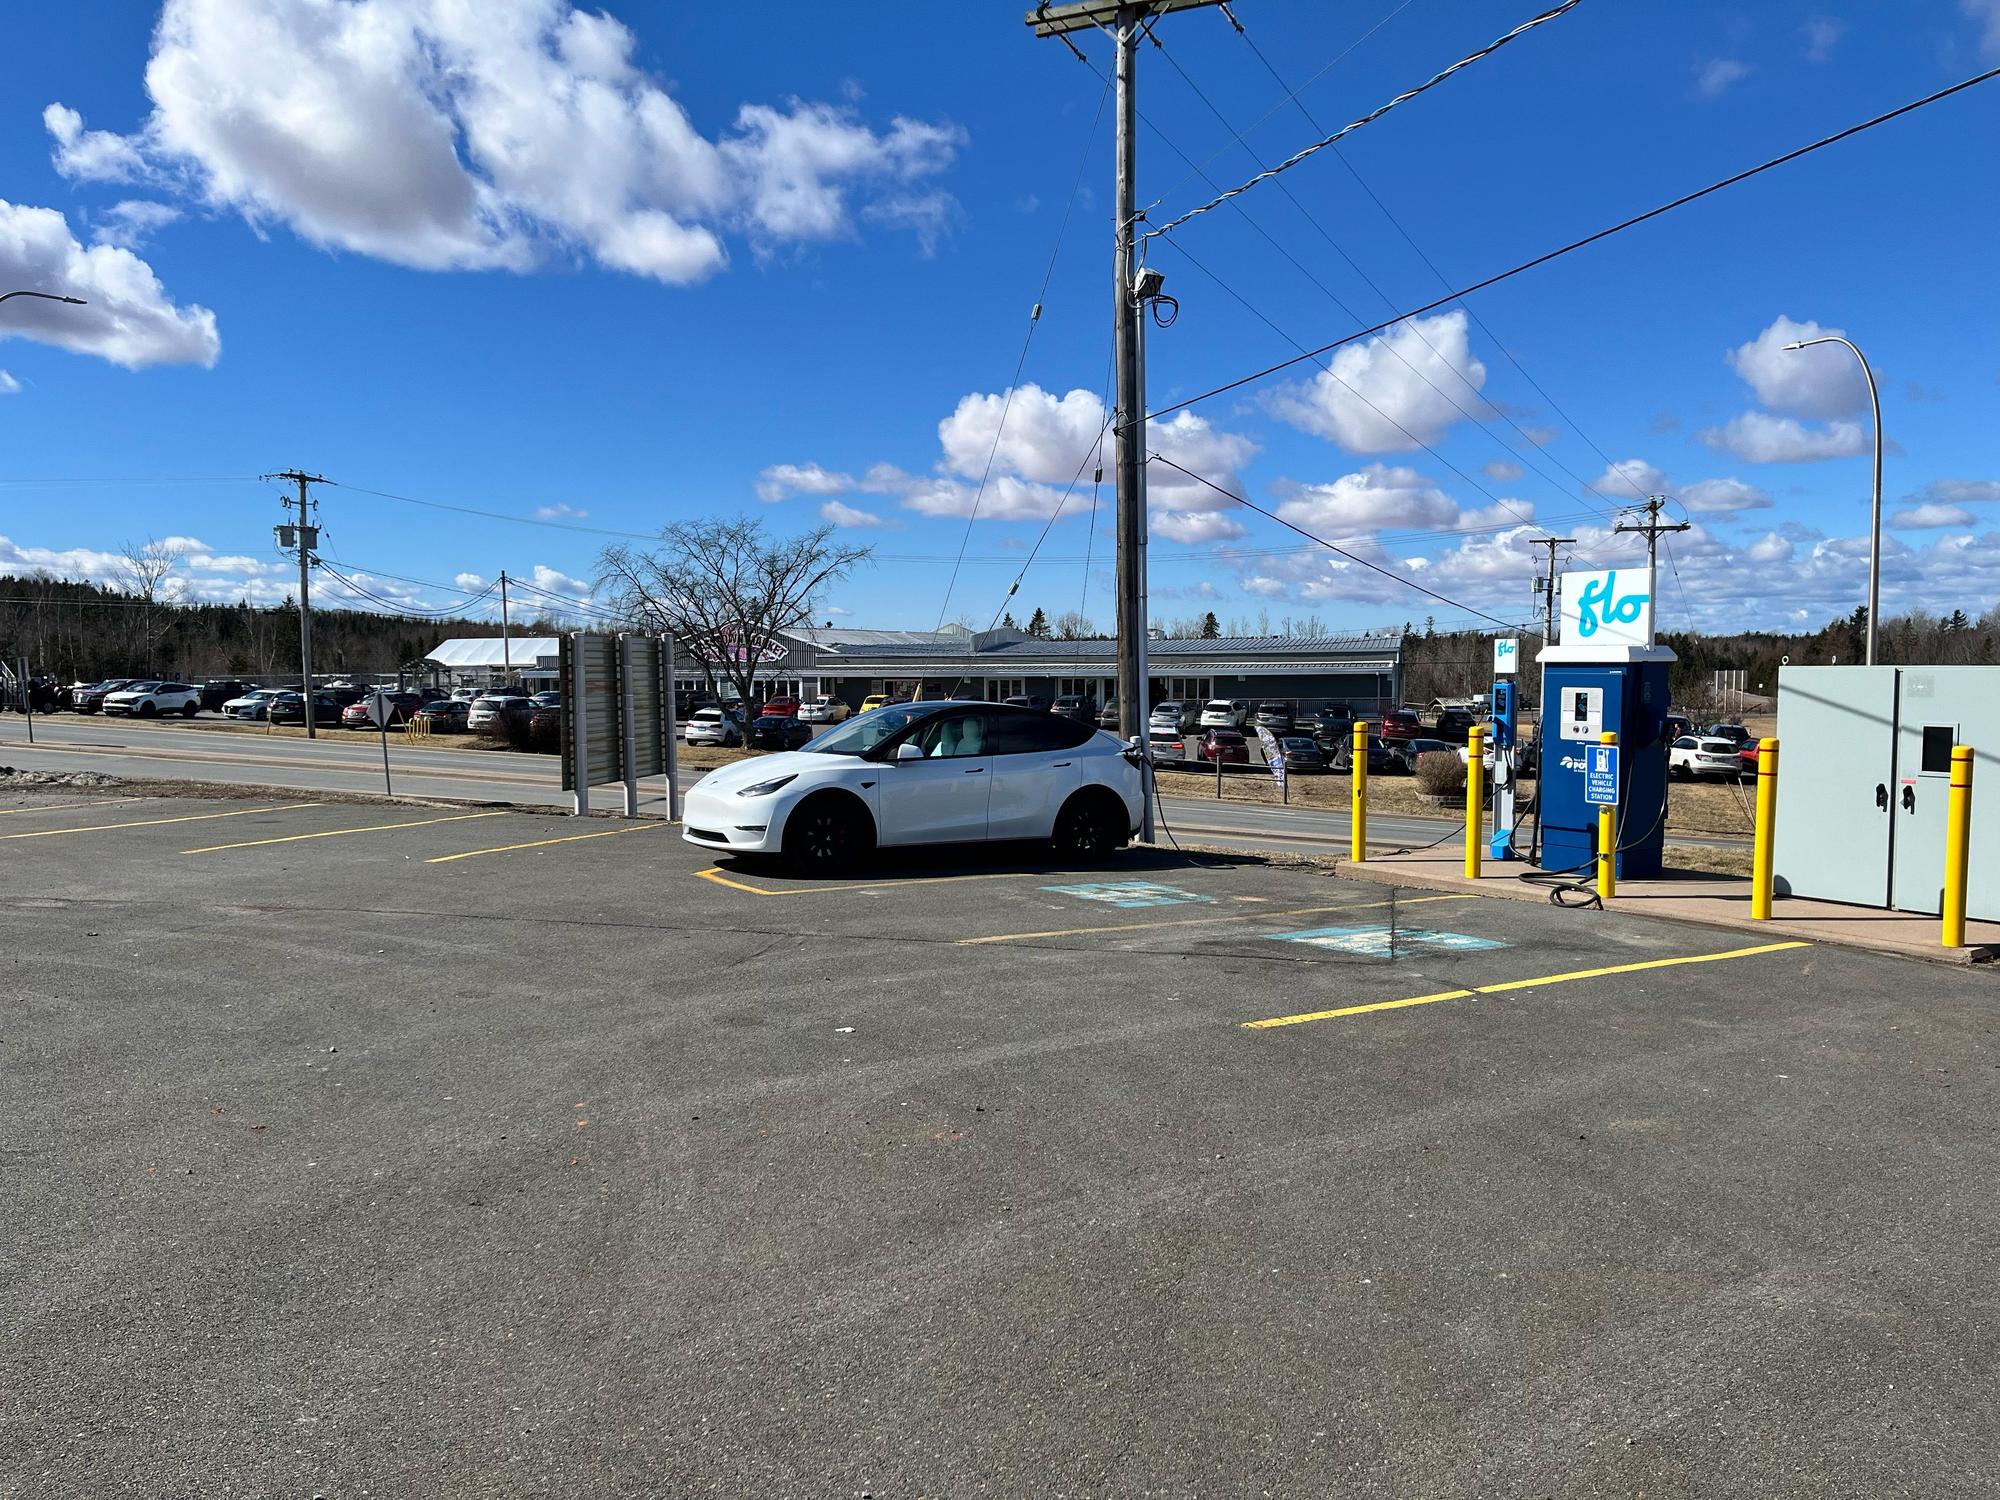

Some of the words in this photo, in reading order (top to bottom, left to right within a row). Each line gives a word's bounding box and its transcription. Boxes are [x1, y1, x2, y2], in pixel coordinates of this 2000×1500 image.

[1578, 571, 1649, 637] flo
[1498, 640, 1515, 657] flo
[1590, 772, 1614, 780] ELECTRIC
[1591, 779, 1613, 787] VEHICLE
[1588, 786, 1615, 794] CHARGING
[1591, 793, 1613, 801] STATION
